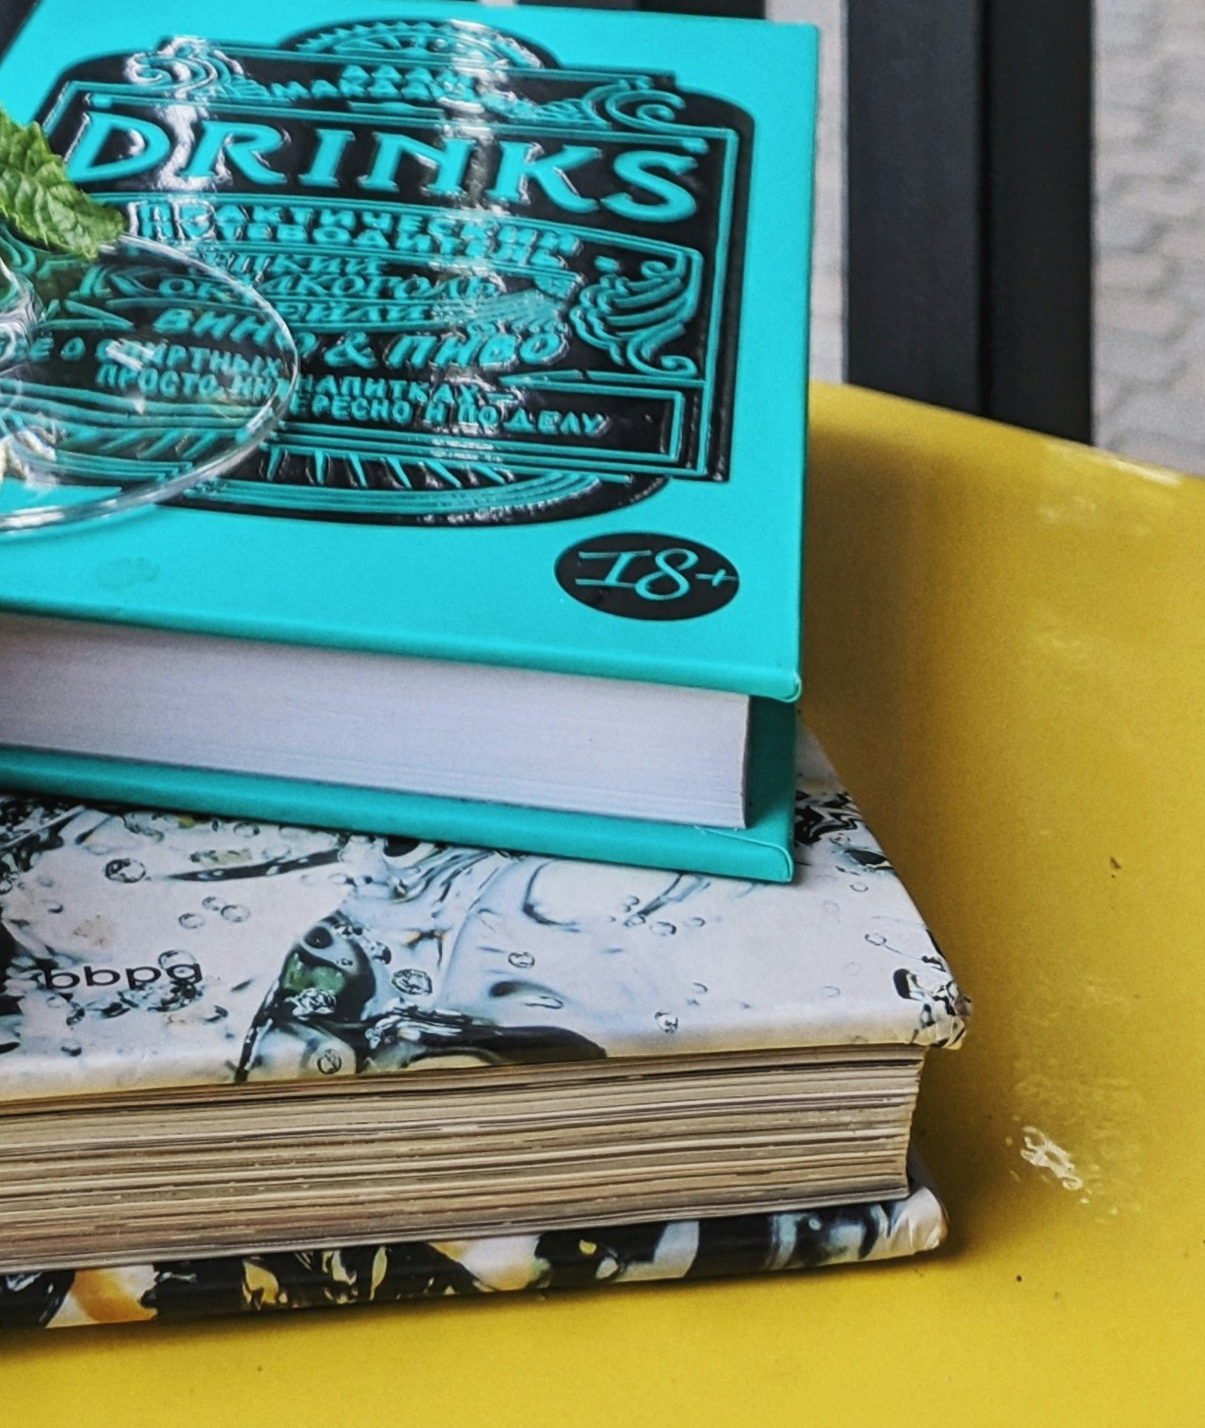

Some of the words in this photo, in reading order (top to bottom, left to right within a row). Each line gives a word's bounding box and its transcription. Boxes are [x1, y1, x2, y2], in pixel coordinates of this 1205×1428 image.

[66, 110, 699, 221] DRINKS
[235, 272, 499, 301] ЛКОГОЛЬ
[385, 333, 569, 374] ПИВО
[296, 374, 479, 407] НАПИТКАХ
[456, 403, 500, 428] ПО
[504, 407, 607, 437] ДЕЛУ
